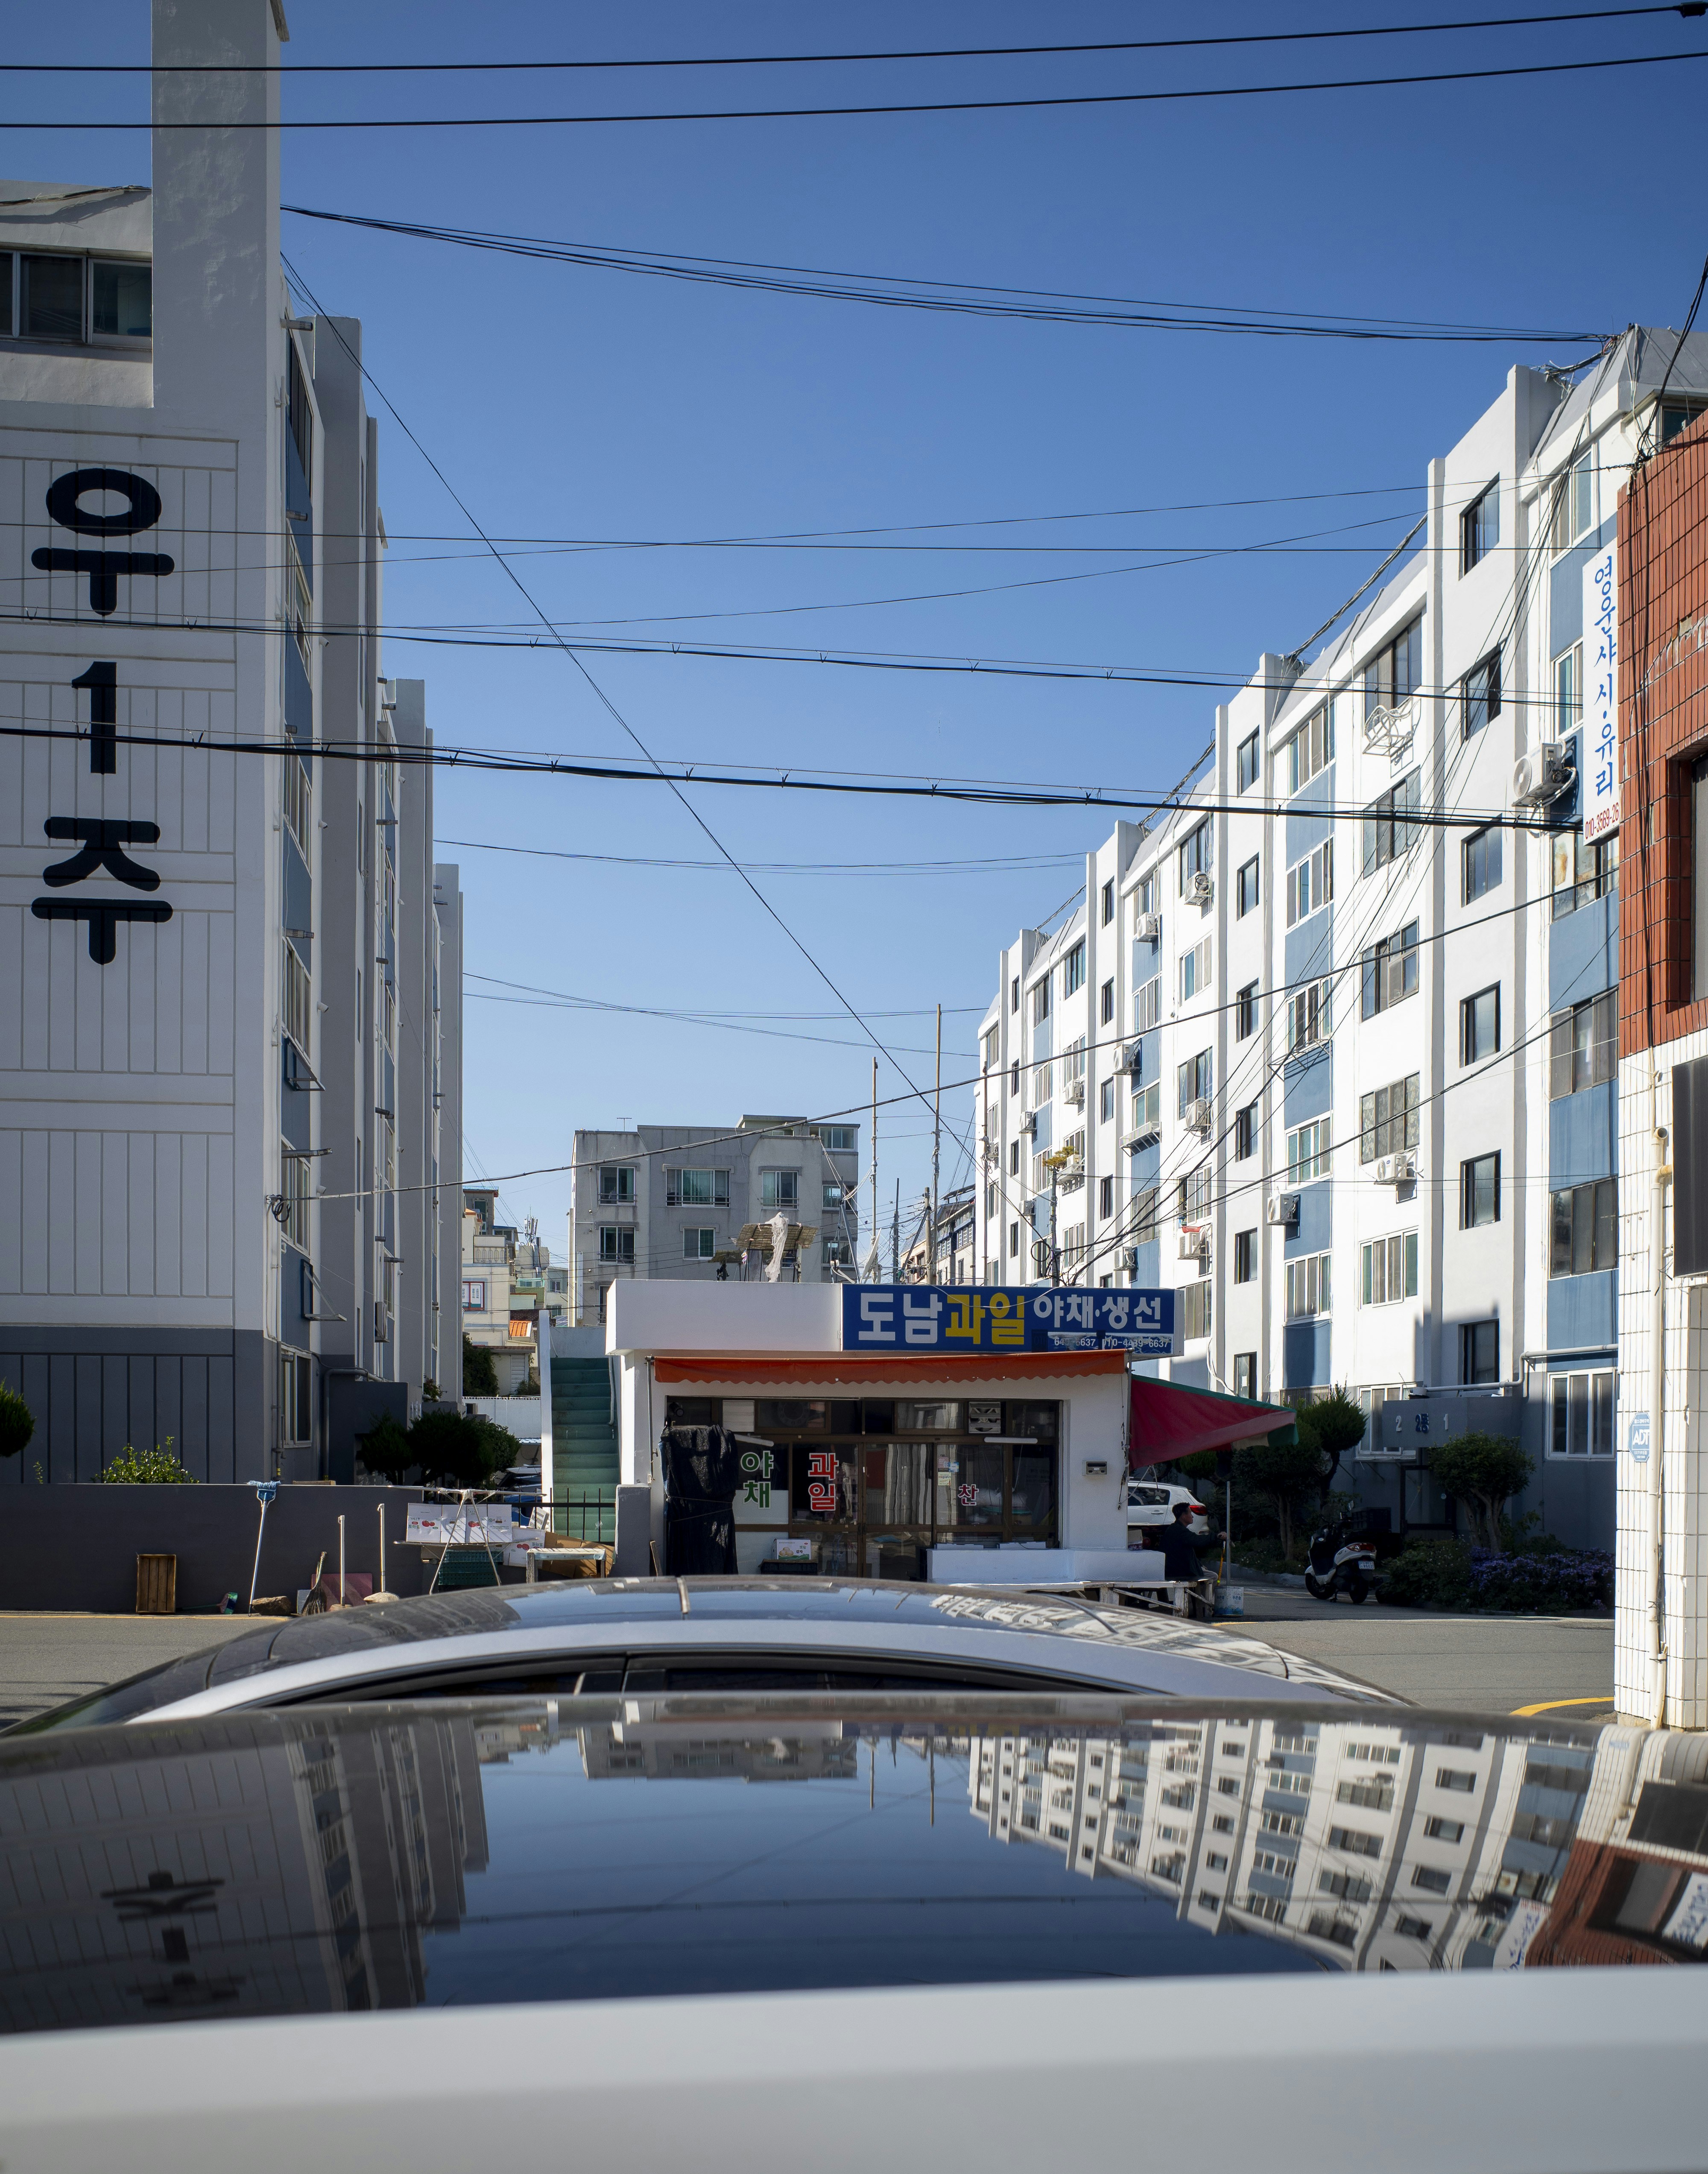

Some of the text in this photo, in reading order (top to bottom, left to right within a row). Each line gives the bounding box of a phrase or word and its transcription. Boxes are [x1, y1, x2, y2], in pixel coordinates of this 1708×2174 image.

[1632, 1429, 1650, 1445] ADT
[740, 1449, 774, 1510] 야채
[807, 1452, 839, 1512] 과일
